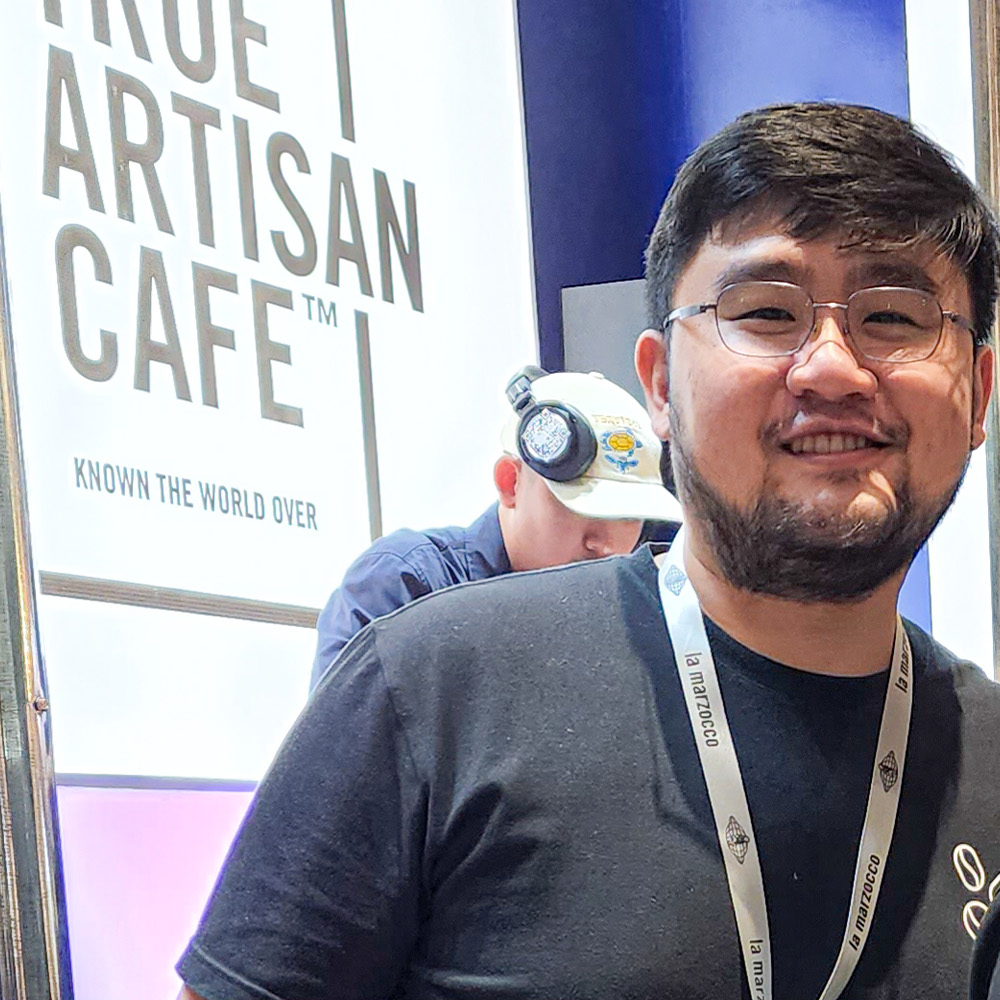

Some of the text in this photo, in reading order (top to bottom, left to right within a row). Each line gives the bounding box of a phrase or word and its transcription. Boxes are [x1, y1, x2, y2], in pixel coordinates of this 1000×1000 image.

[43, 0, 281, 114] UE
[42, 43, 425, 314] ARTISAN
[74, 456, 318, 531] KNOWN THE WORLD OVER
[684, 652, 719, 748] la marzocco
[749, 939, 764, 954] la
[849, 854, 881, 951] la marzocco
